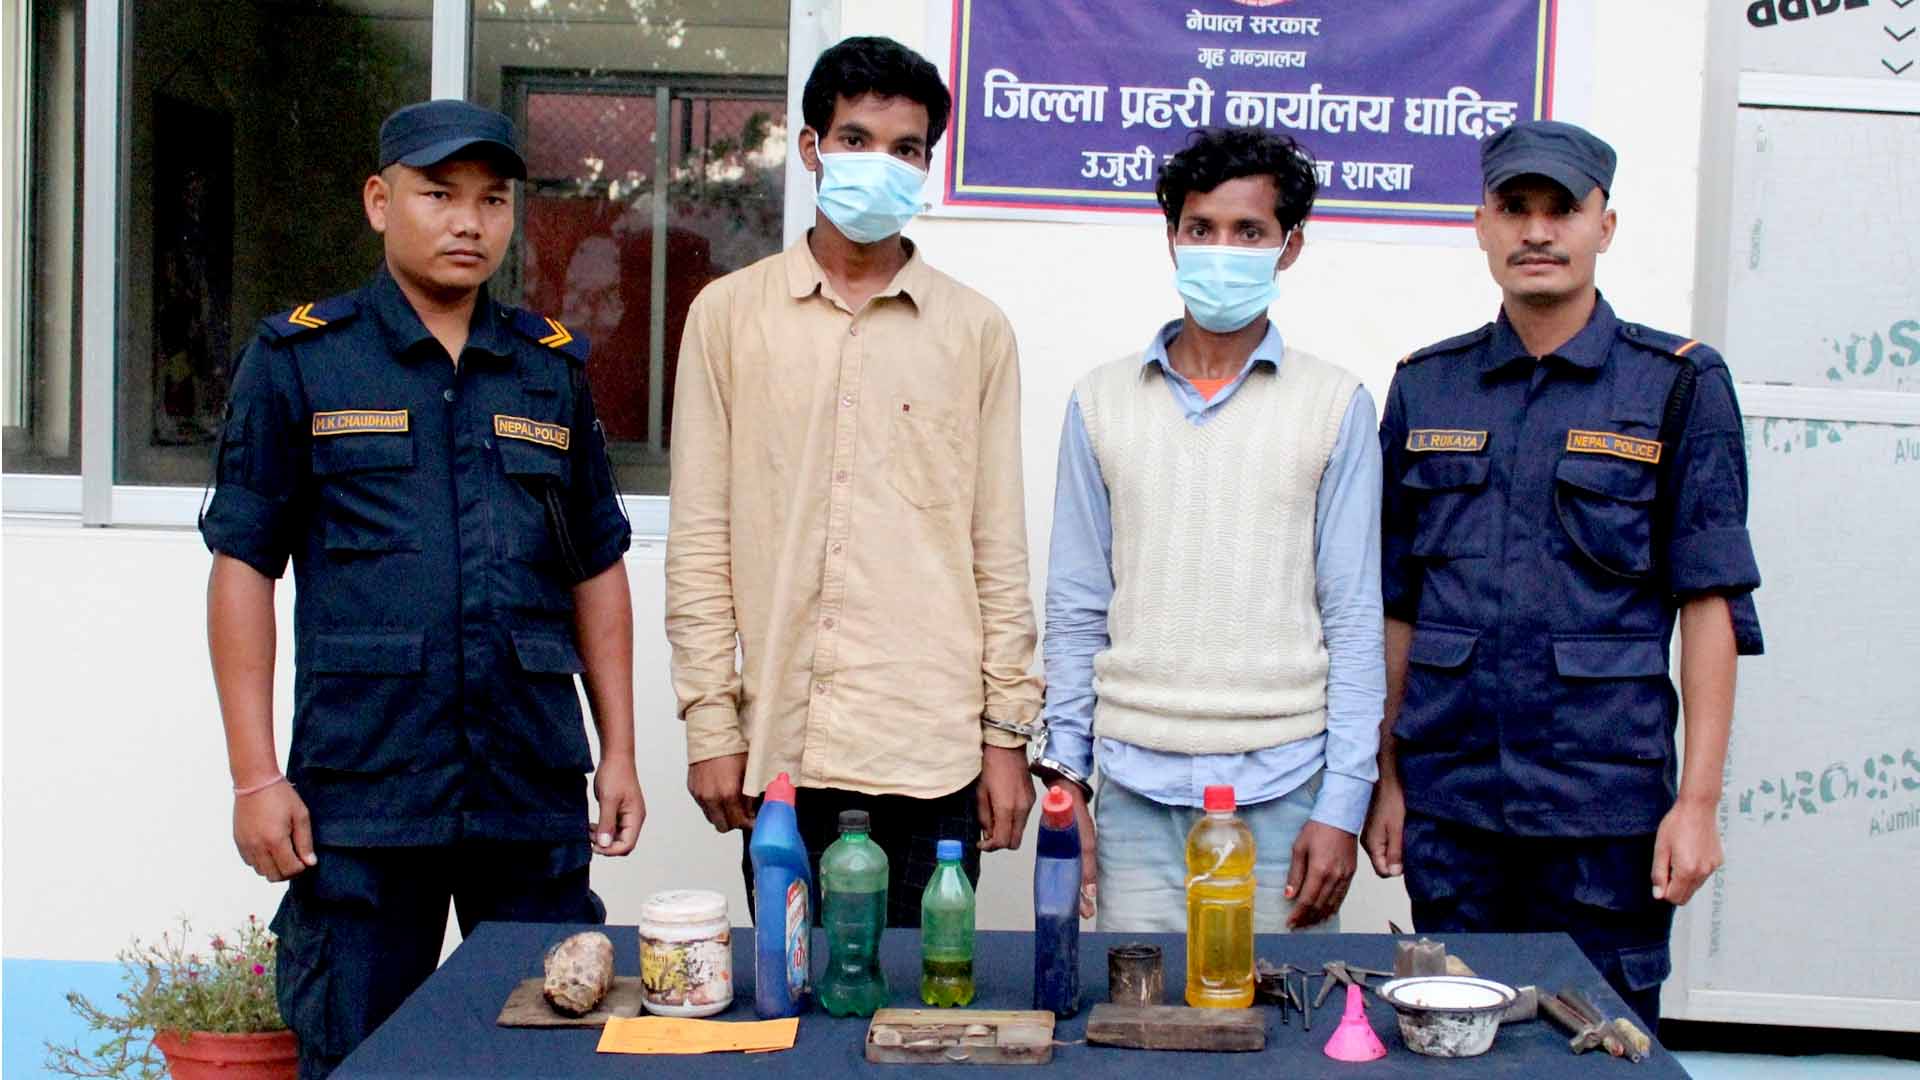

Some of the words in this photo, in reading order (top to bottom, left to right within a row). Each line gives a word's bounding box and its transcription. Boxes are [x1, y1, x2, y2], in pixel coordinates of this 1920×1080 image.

[1186, 9, 1244, 33] नेपाल
[1249, 15, 1322, 36] सरकार
[1197, 48, 1226, 69] गृह
[1229, 48, 1307, 68] मन्त्रालय
[983, 68, 1108, 123] जिल्ला
[1119, 77, 1215, 128] प्रहरी
[1225, 83, 1394, 133] कार्यालय
[1081, 145, 1155, 187] उजुरी
[1341, 160, 1413, 190] शाखा
[498, 419, 534, 437] NEPAL
[1573, 434, 1608, 449] NEPAL
[1615, 439, 1655, 457] POLICE
